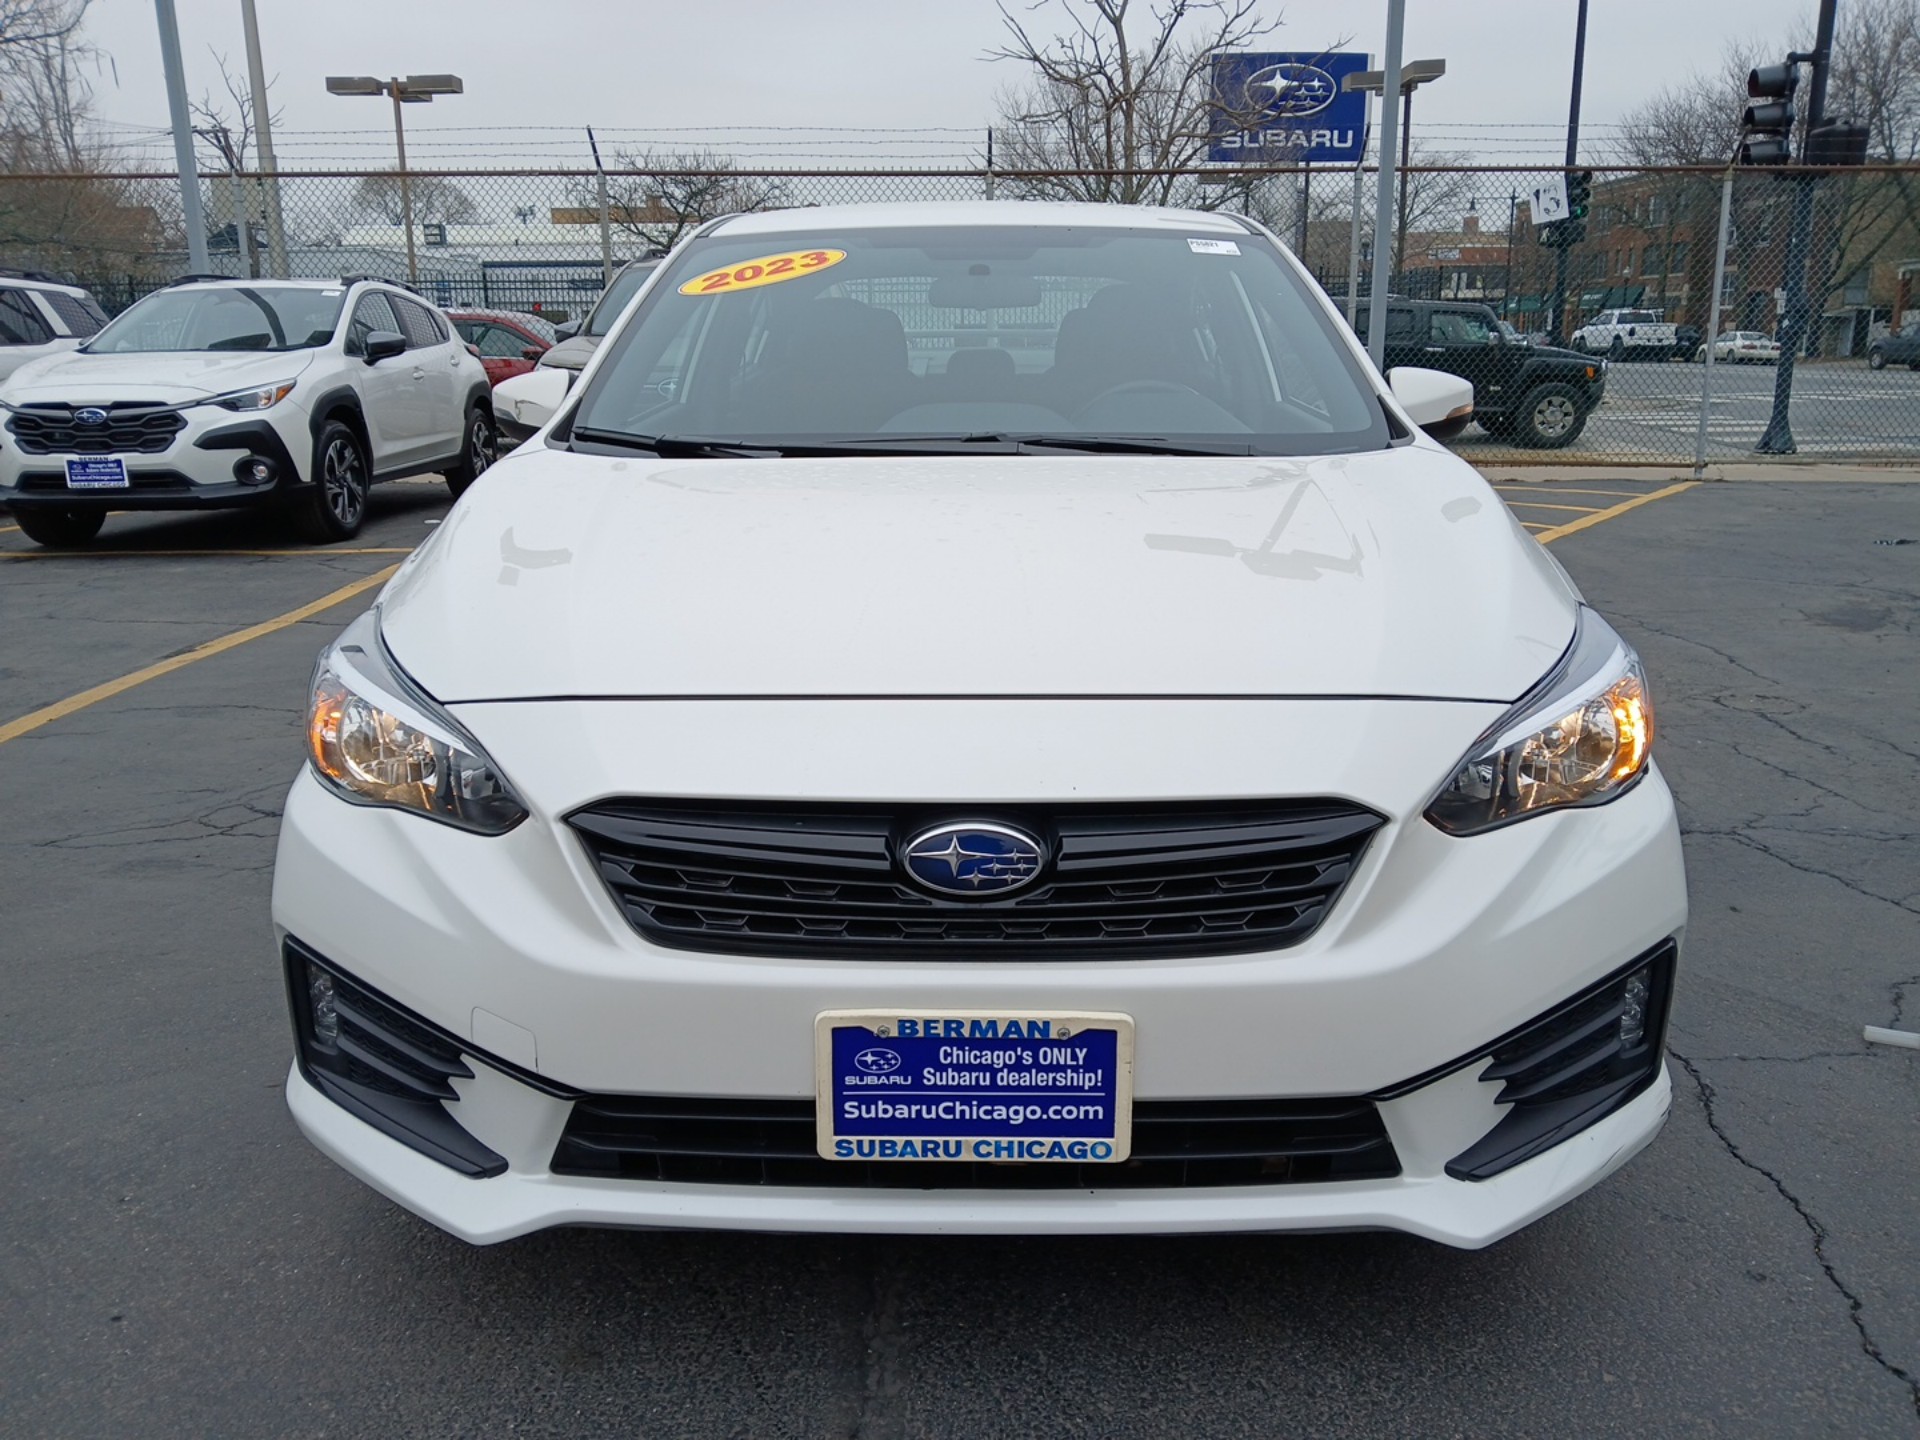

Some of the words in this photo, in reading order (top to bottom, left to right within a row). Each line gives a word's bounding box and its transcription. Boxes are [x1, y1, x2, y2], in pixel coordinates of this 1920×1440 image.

[1220, 129, 1353, 148] SUBARU
[700, 251, 830, 292] 2023
[897, 1019, 1051, 1039] BERMAN
[939, 1046, 1033, 1069] Chicago's
[1038, 1047, 1088, 1066] ONLY
[844, 1075, 912, 1085] SUBARU
[922, 1068, 990, 1087] Subaru
[996, 1069, 1103, 1090] dealership!
[843, 1101, 1104, 1124] SubaruChicago.com
[834, 1139, 963, 1158] SUBARU
[972, 1140, 1113, 1160] CHICAGO
